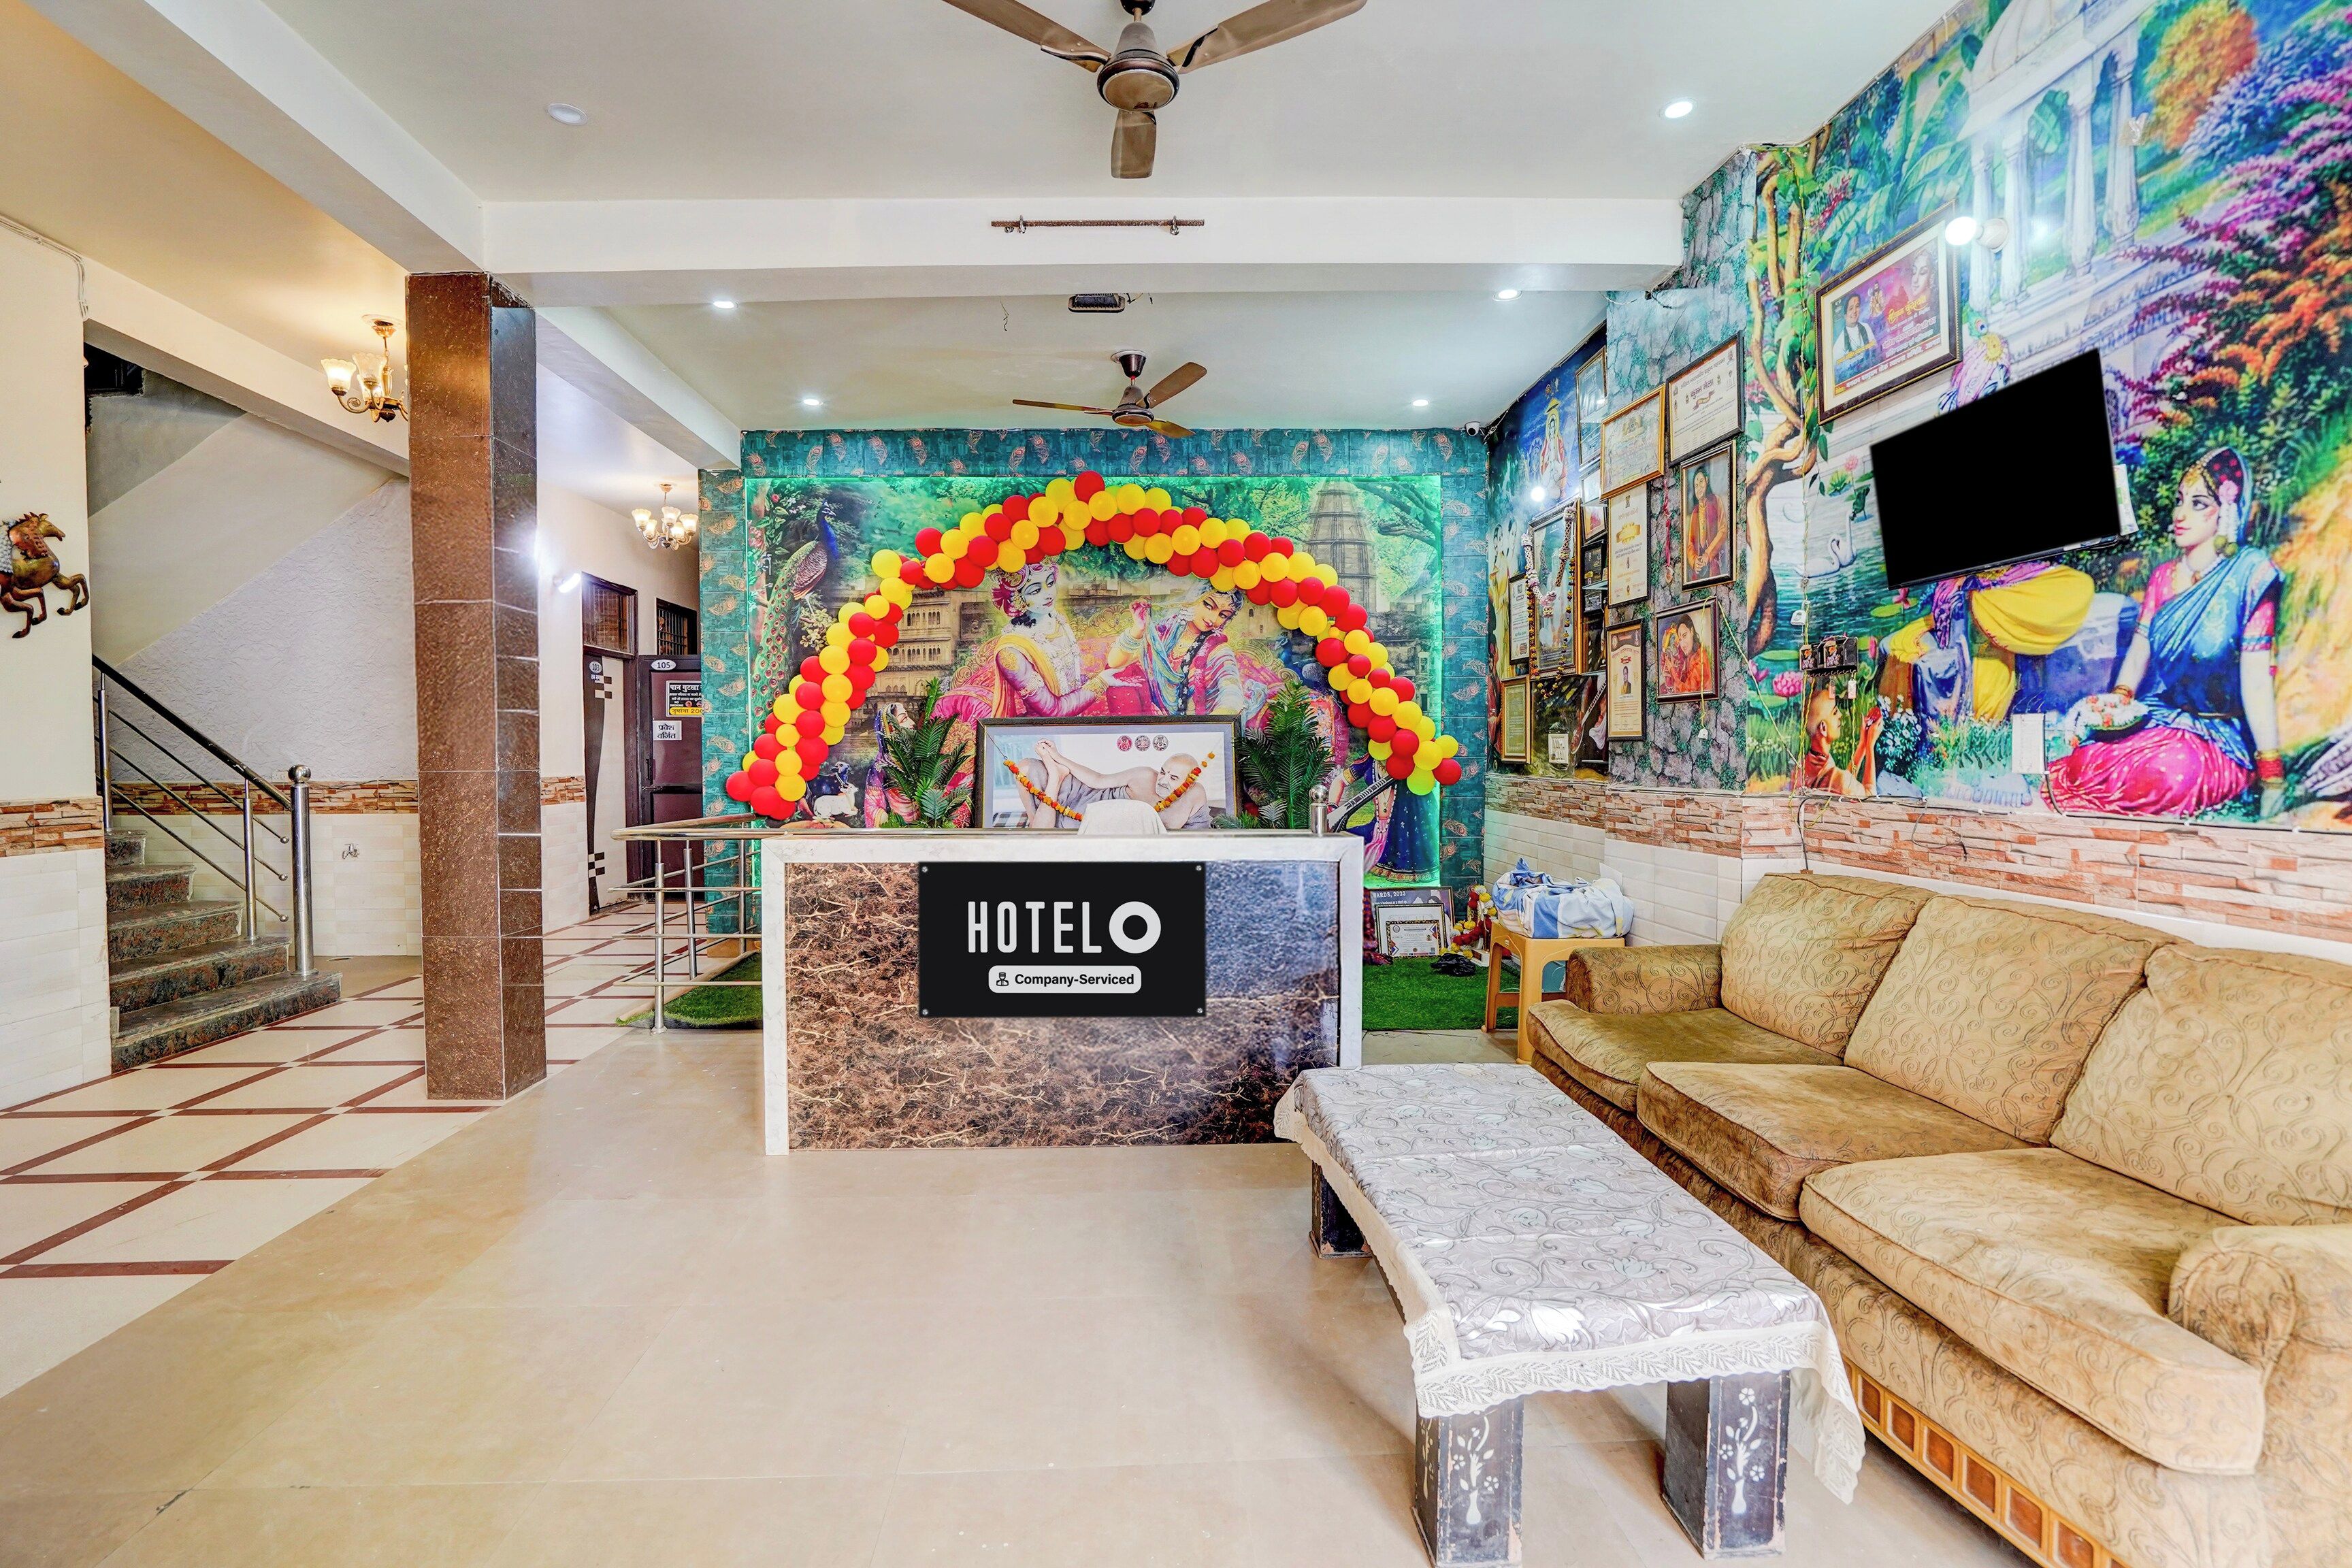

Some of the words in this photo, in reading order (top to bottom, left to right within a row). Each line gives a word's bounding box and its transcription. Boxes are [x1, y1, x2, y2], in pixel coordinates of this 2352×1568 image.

[682, 685, 700, 693] गुटखा
[968, 901, 1102, 953] HOTEL
[1015, 973, 1135, 987] Company-Serviced
